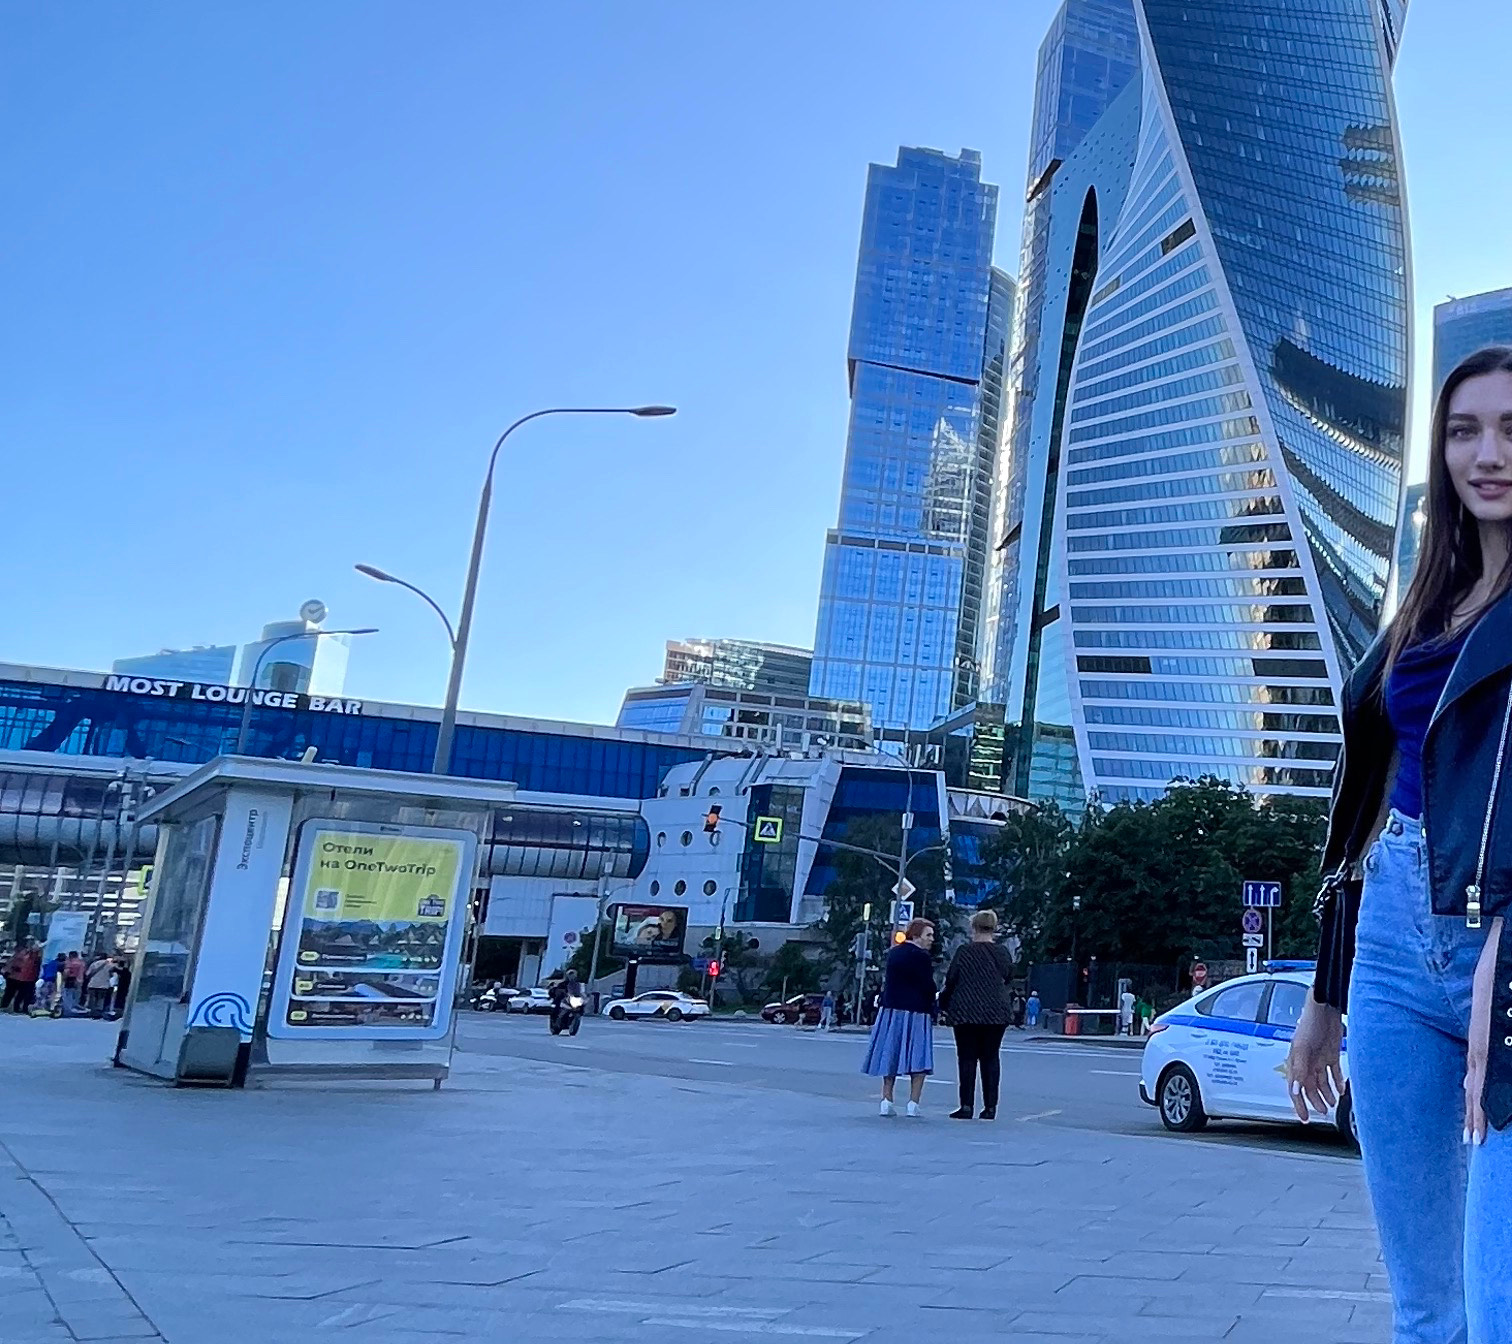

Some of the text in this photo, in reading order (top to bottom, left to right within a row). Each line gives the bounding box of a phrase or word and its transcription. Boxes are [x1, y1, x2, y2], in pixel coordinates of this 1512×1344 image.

[105, 675, 362, 715] MOST LOUNGE BAR
[322, 841, 374, 856] Отели
[320, 859, 436, 877] на OneTwoTrip
